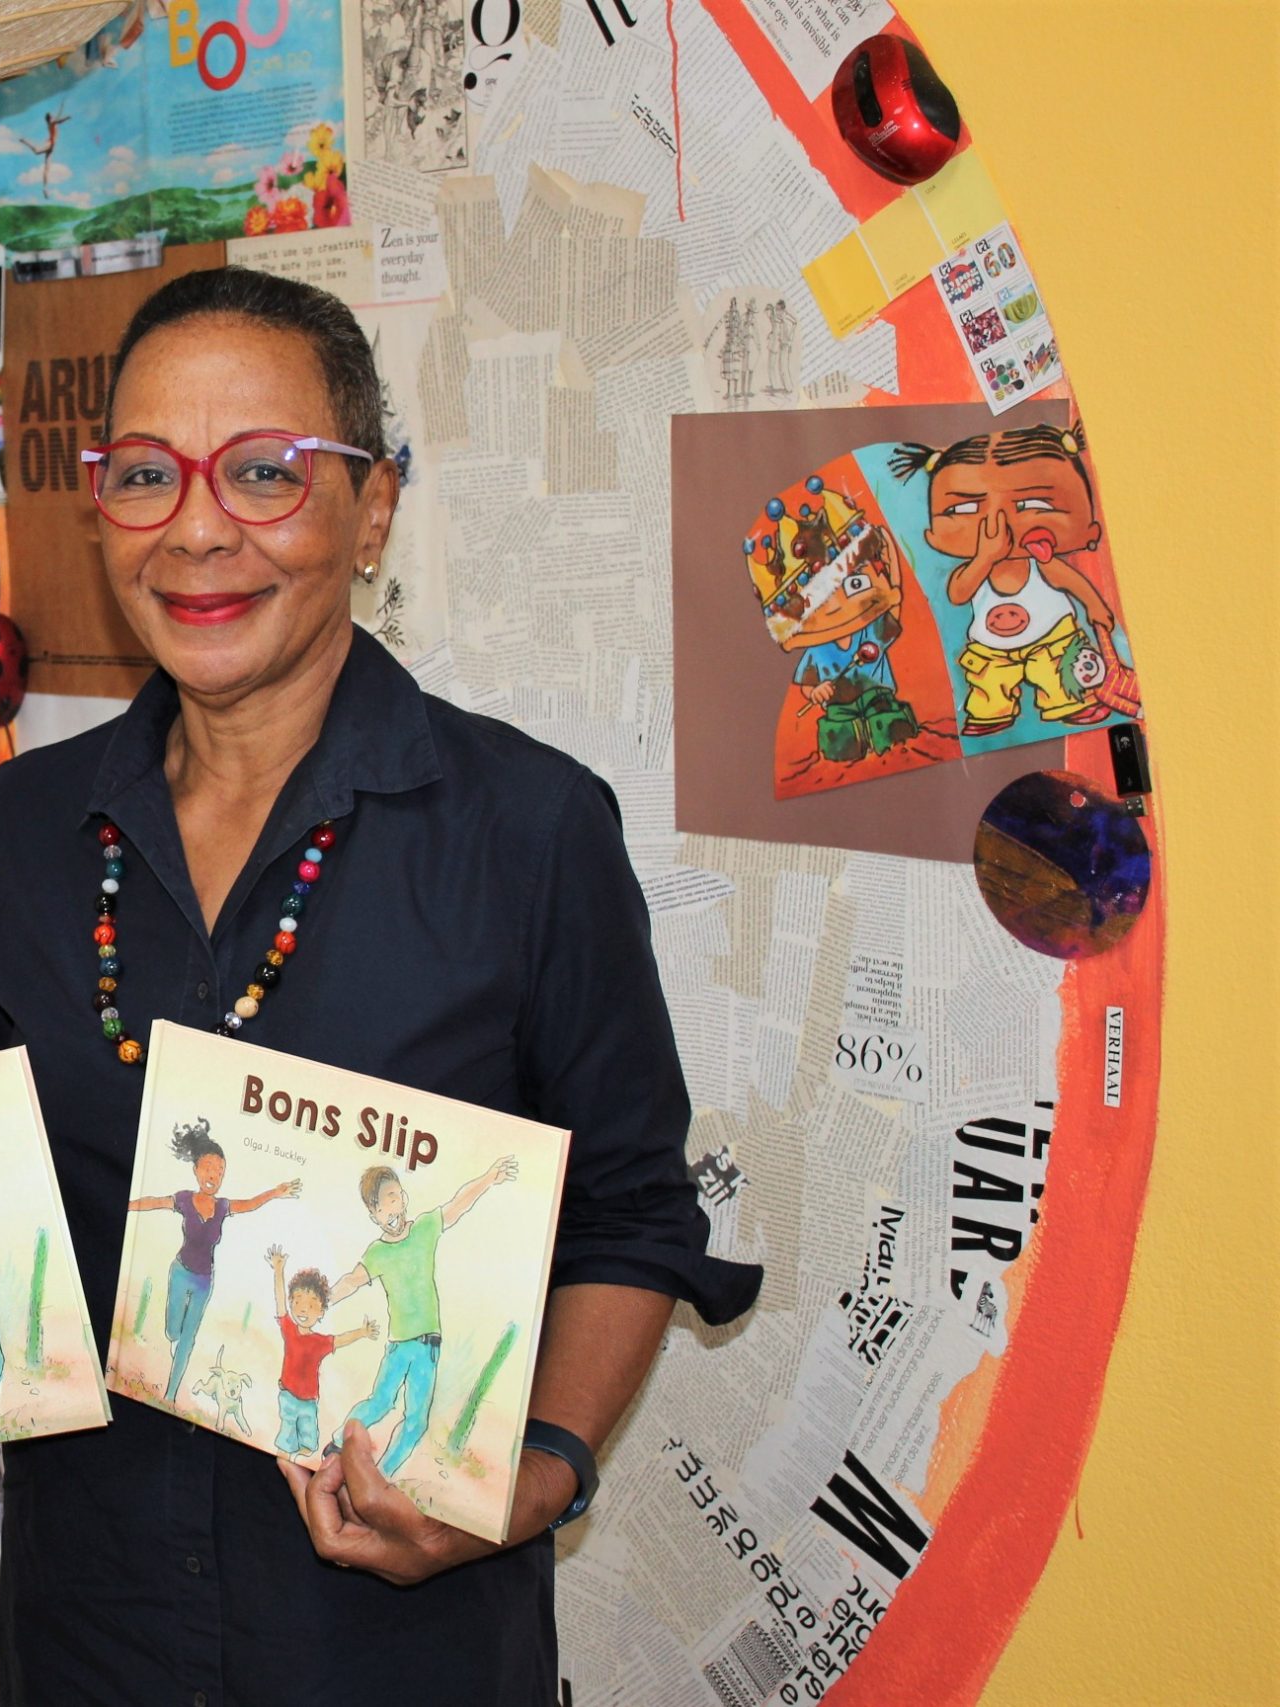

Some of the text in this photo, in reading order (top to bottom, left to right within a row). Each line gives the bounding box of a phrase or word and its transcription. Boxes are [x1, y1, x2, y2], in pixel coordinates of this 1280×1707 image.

[799, 16, 836, 59] invisible
[381, 227, 440, 250] Zen is your
[381, 250, 425, 269] everyday
[381, 268, 422, 286] thought.
[983, 242, 1017, 279] 60
[19, 353, 119, 423] ARU
[21, 427, 80, 492] ON
[1106, 1010, 1123, 1104] VERHAAL
[242, 1074, 439, 1171] Bons Slip
[243, 1137, 307, 1166] Olga J. Buckley
